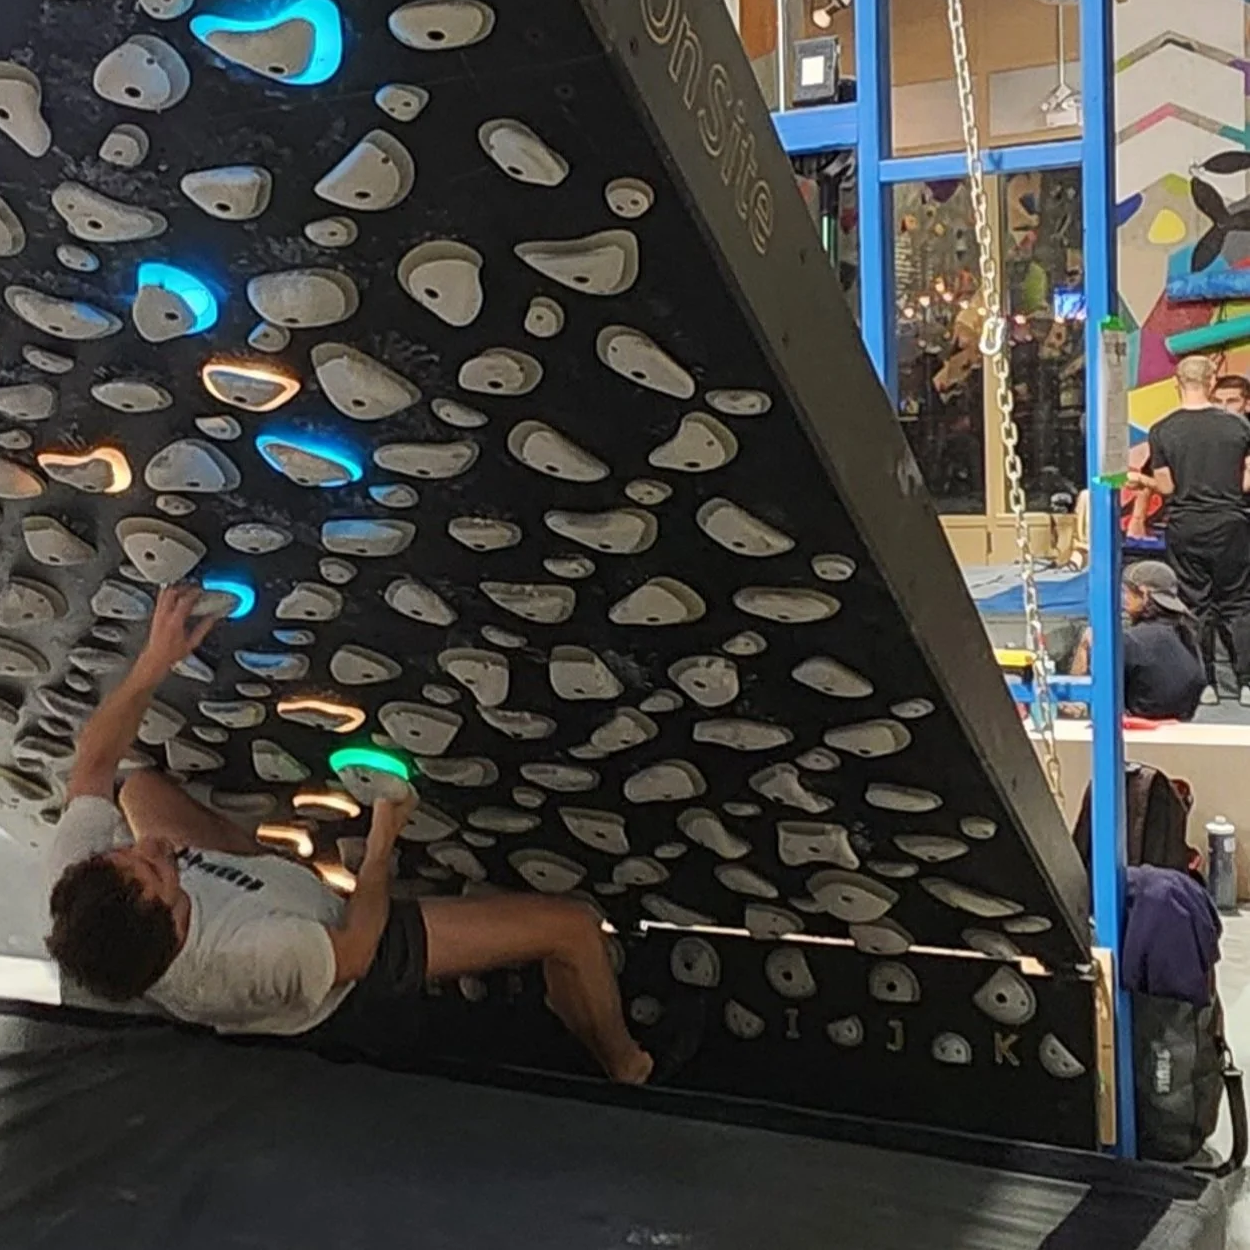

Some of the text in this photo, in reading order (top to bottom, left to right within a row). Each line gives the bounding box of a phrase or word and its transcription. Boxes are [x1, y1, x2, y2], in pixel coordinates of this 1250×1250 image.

[785, 1007, 801, 1040] I
[886, 1018, 905, 1052] J
[994, 1031, 1021, 1068] K
